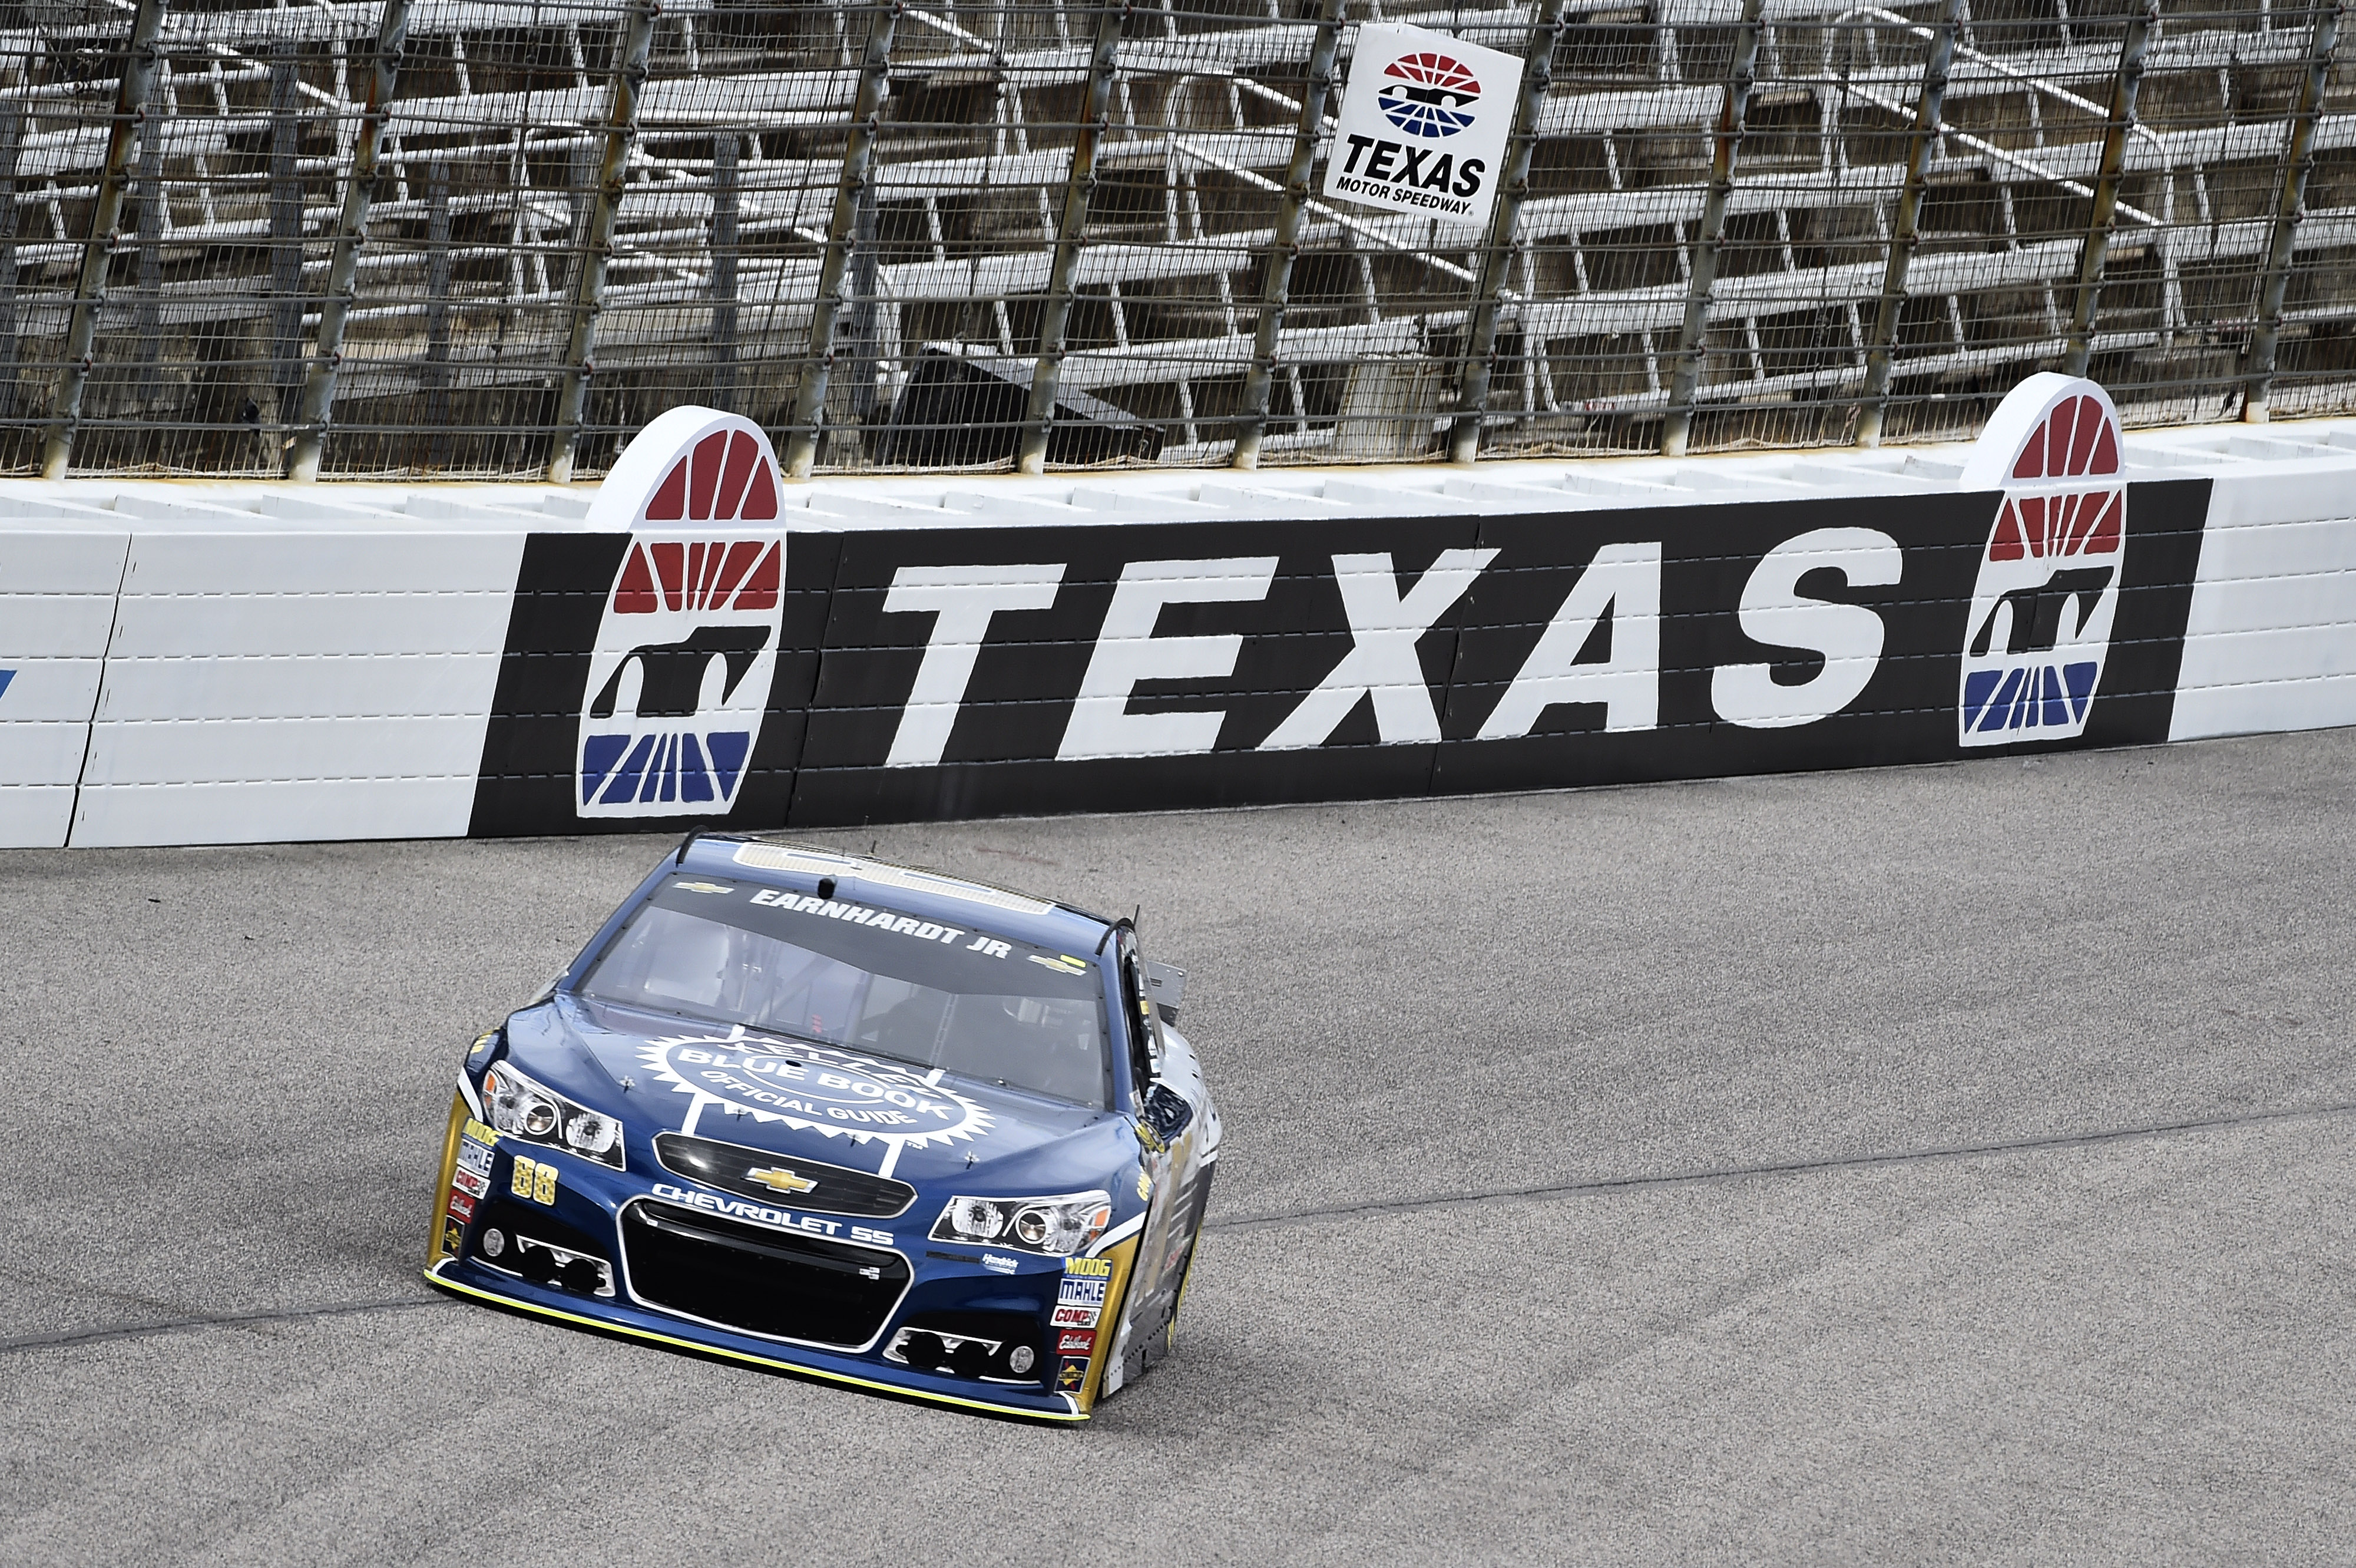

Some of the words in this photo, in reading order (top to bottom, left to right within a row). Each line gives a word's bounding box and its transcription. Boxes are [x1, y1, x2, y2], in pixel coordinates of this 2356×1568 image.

[1336, 176, 1391, 199] MOTOR
[1343, 133, 1486, 197] TEXAS
[883, 527, 1902, 767] TEXAS
[749, 889, 965, 944] EARNHARDT
[966, 937, 1012, 960] JR
[677, 1048, 806, 1083] BLUE
[817, 1071, 953, 1120] BOOK
[700, 1070, 822, 1117] OFFICIAL
[826, 1106, 918, 1126] GUIDE
[511, 1155, 559, 1206] 88
[651, 1183, 842, 1236] CHEVROLET
[851, 1227, 894, 1246] SS
[1060, 1281, 1105, 1302] MAHLE
[1064, 1257, 1112, 1277] MOOG
[1054, 1308, 1090, 1323] COMP
